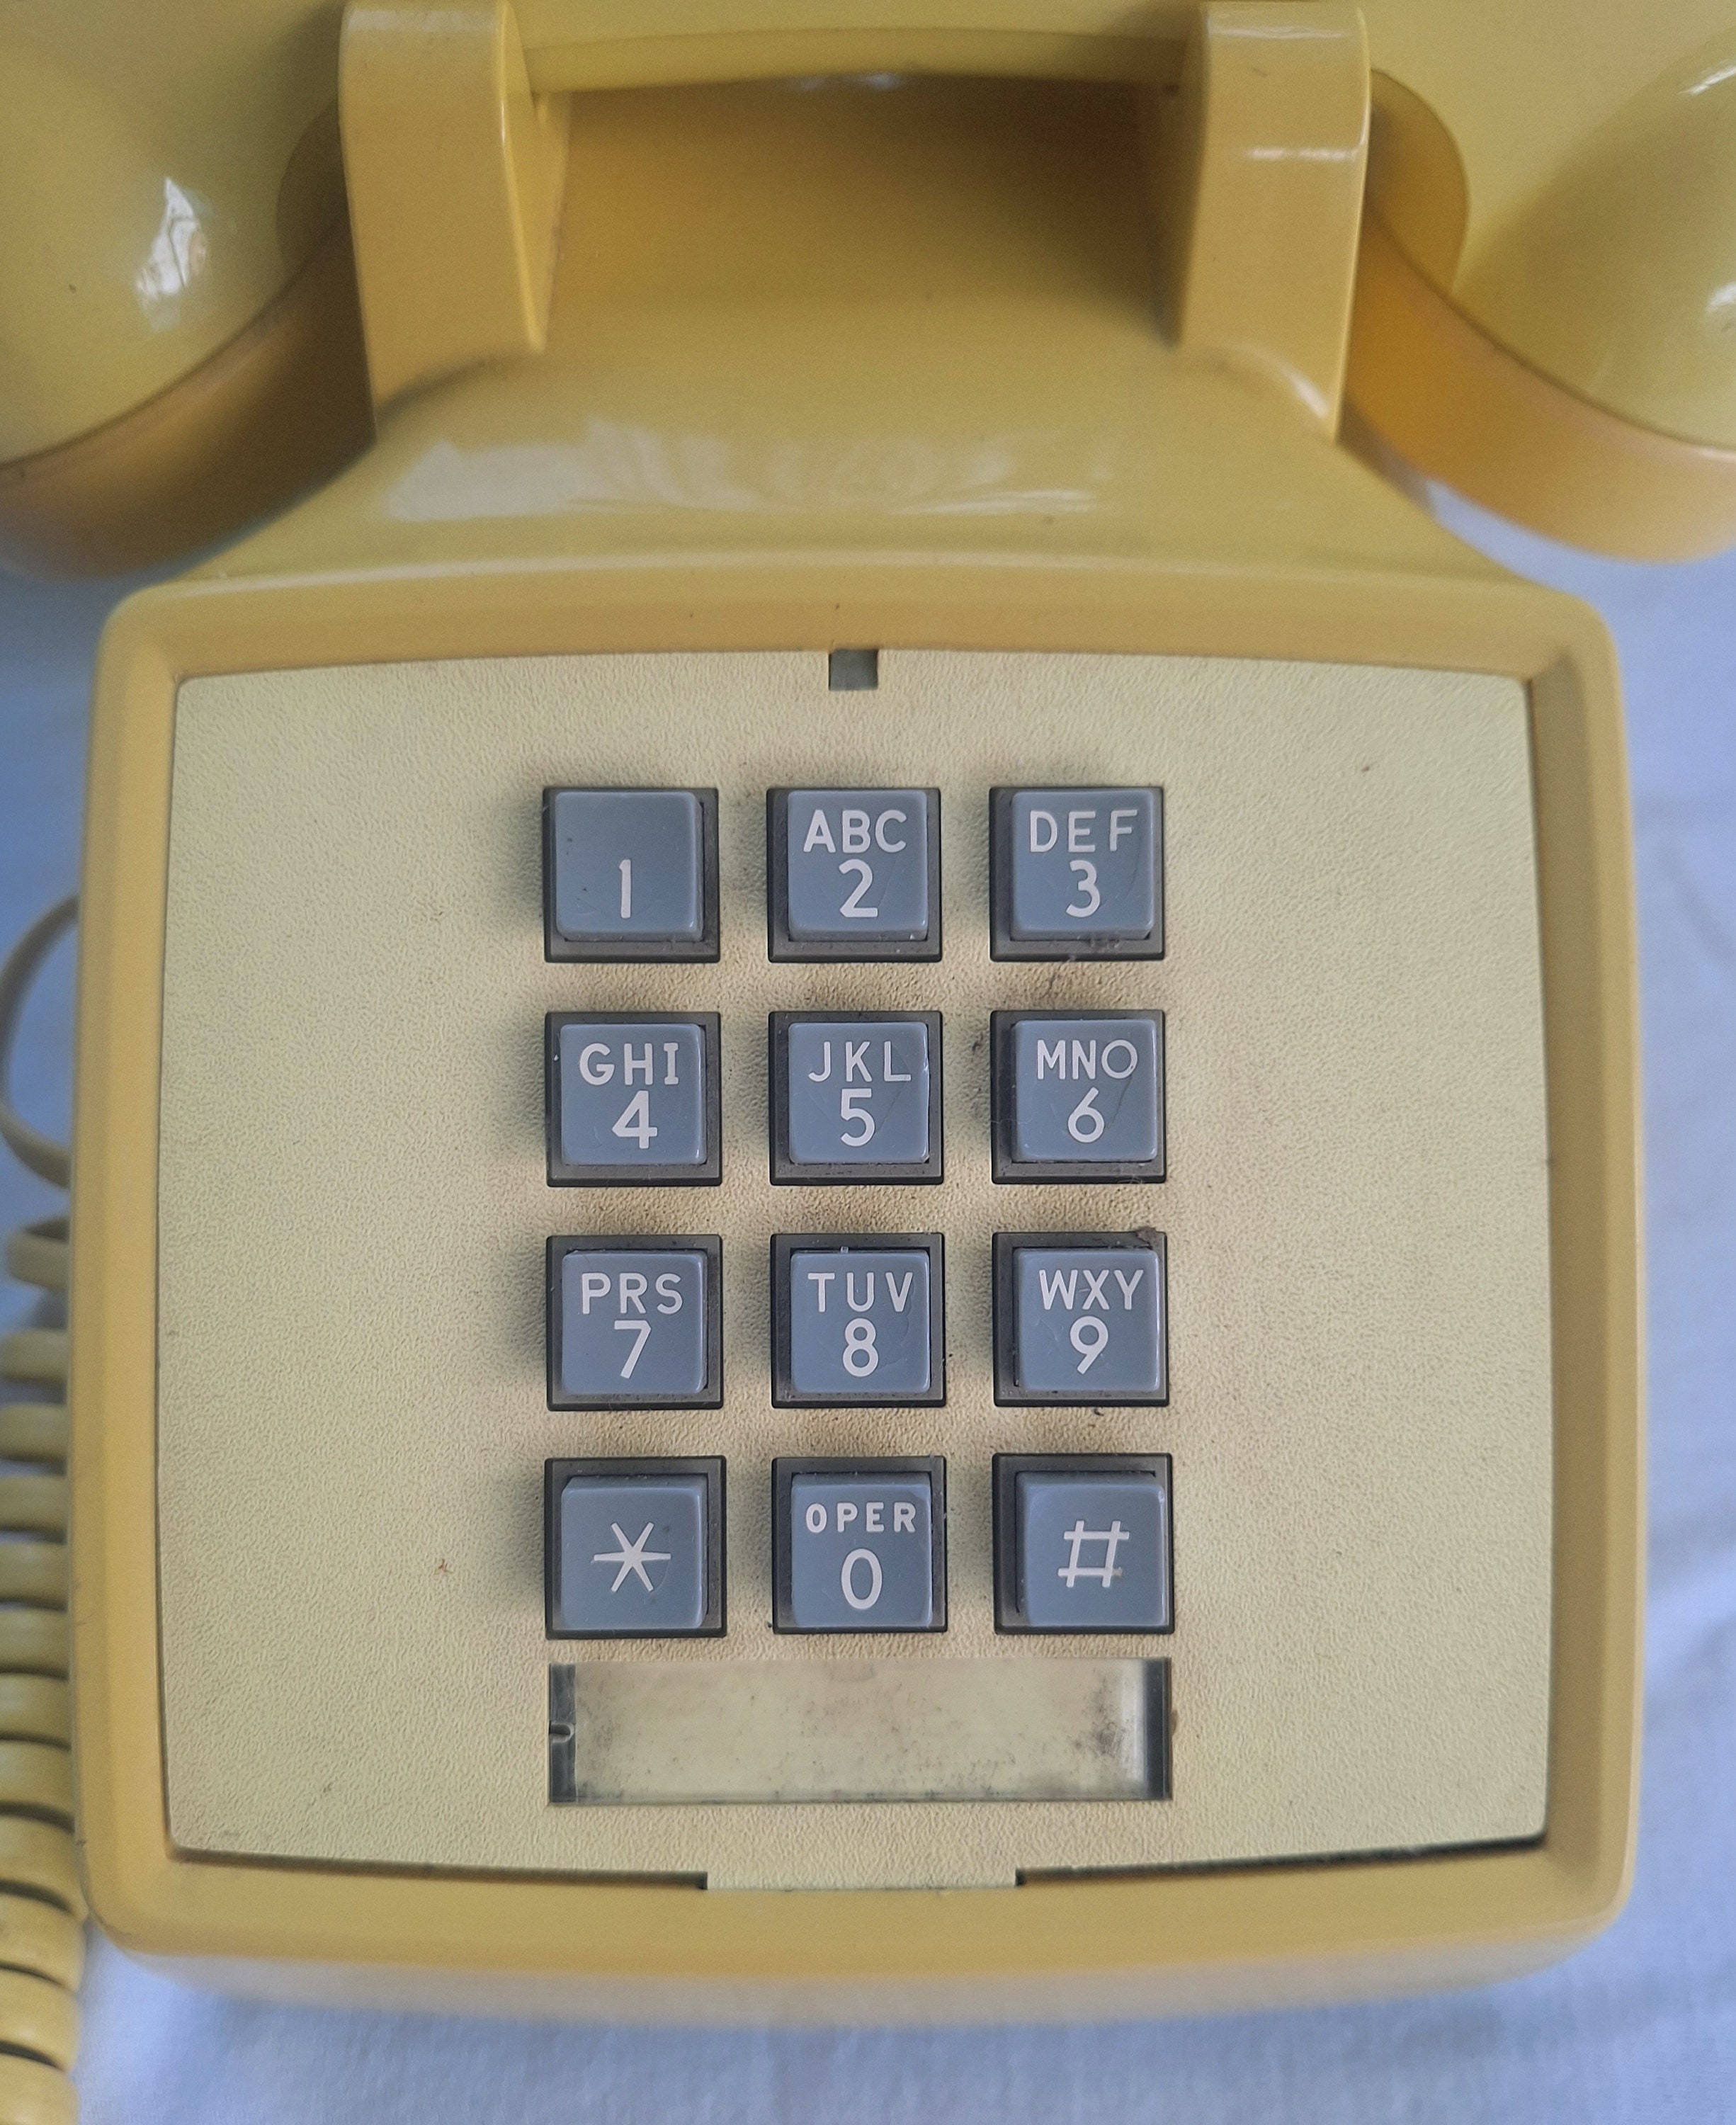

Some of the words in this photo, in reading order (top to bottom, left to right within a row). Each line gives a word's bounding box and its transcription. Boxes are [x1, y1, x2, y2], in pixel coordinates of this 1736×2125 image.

[803, 809, 907, 853] ABC
[1030, 809, 1138, 852] DEF
[618, 858, 632, 919] 1
[839, 858, 878, 917] 2
[1066, 859, 1101, 918] 3
[579, 1043, 679, 1085] GHI
[808, 1041, 912, 1082] JKL
[1037, 1039, 1138, 1080] MNO
[611, 1090, 658, 1150] 4
[841, 1088, 875, 1147] 5
[1067, 1087, 1105, 1143] 6
[581, 1272, 683, 1315] PRS
[807, 1271, 913, 1313] TUV
[1039, 1269, 1144, 1310] WXY
[614, 1320, 652, 1378] 7
[842, 1318, 879, 1377] 8
[1070, 1315, 1109, 1374] 9
[805, 1502, 916, 1534] OPER
[841, 1548, 883, 1610] 0
